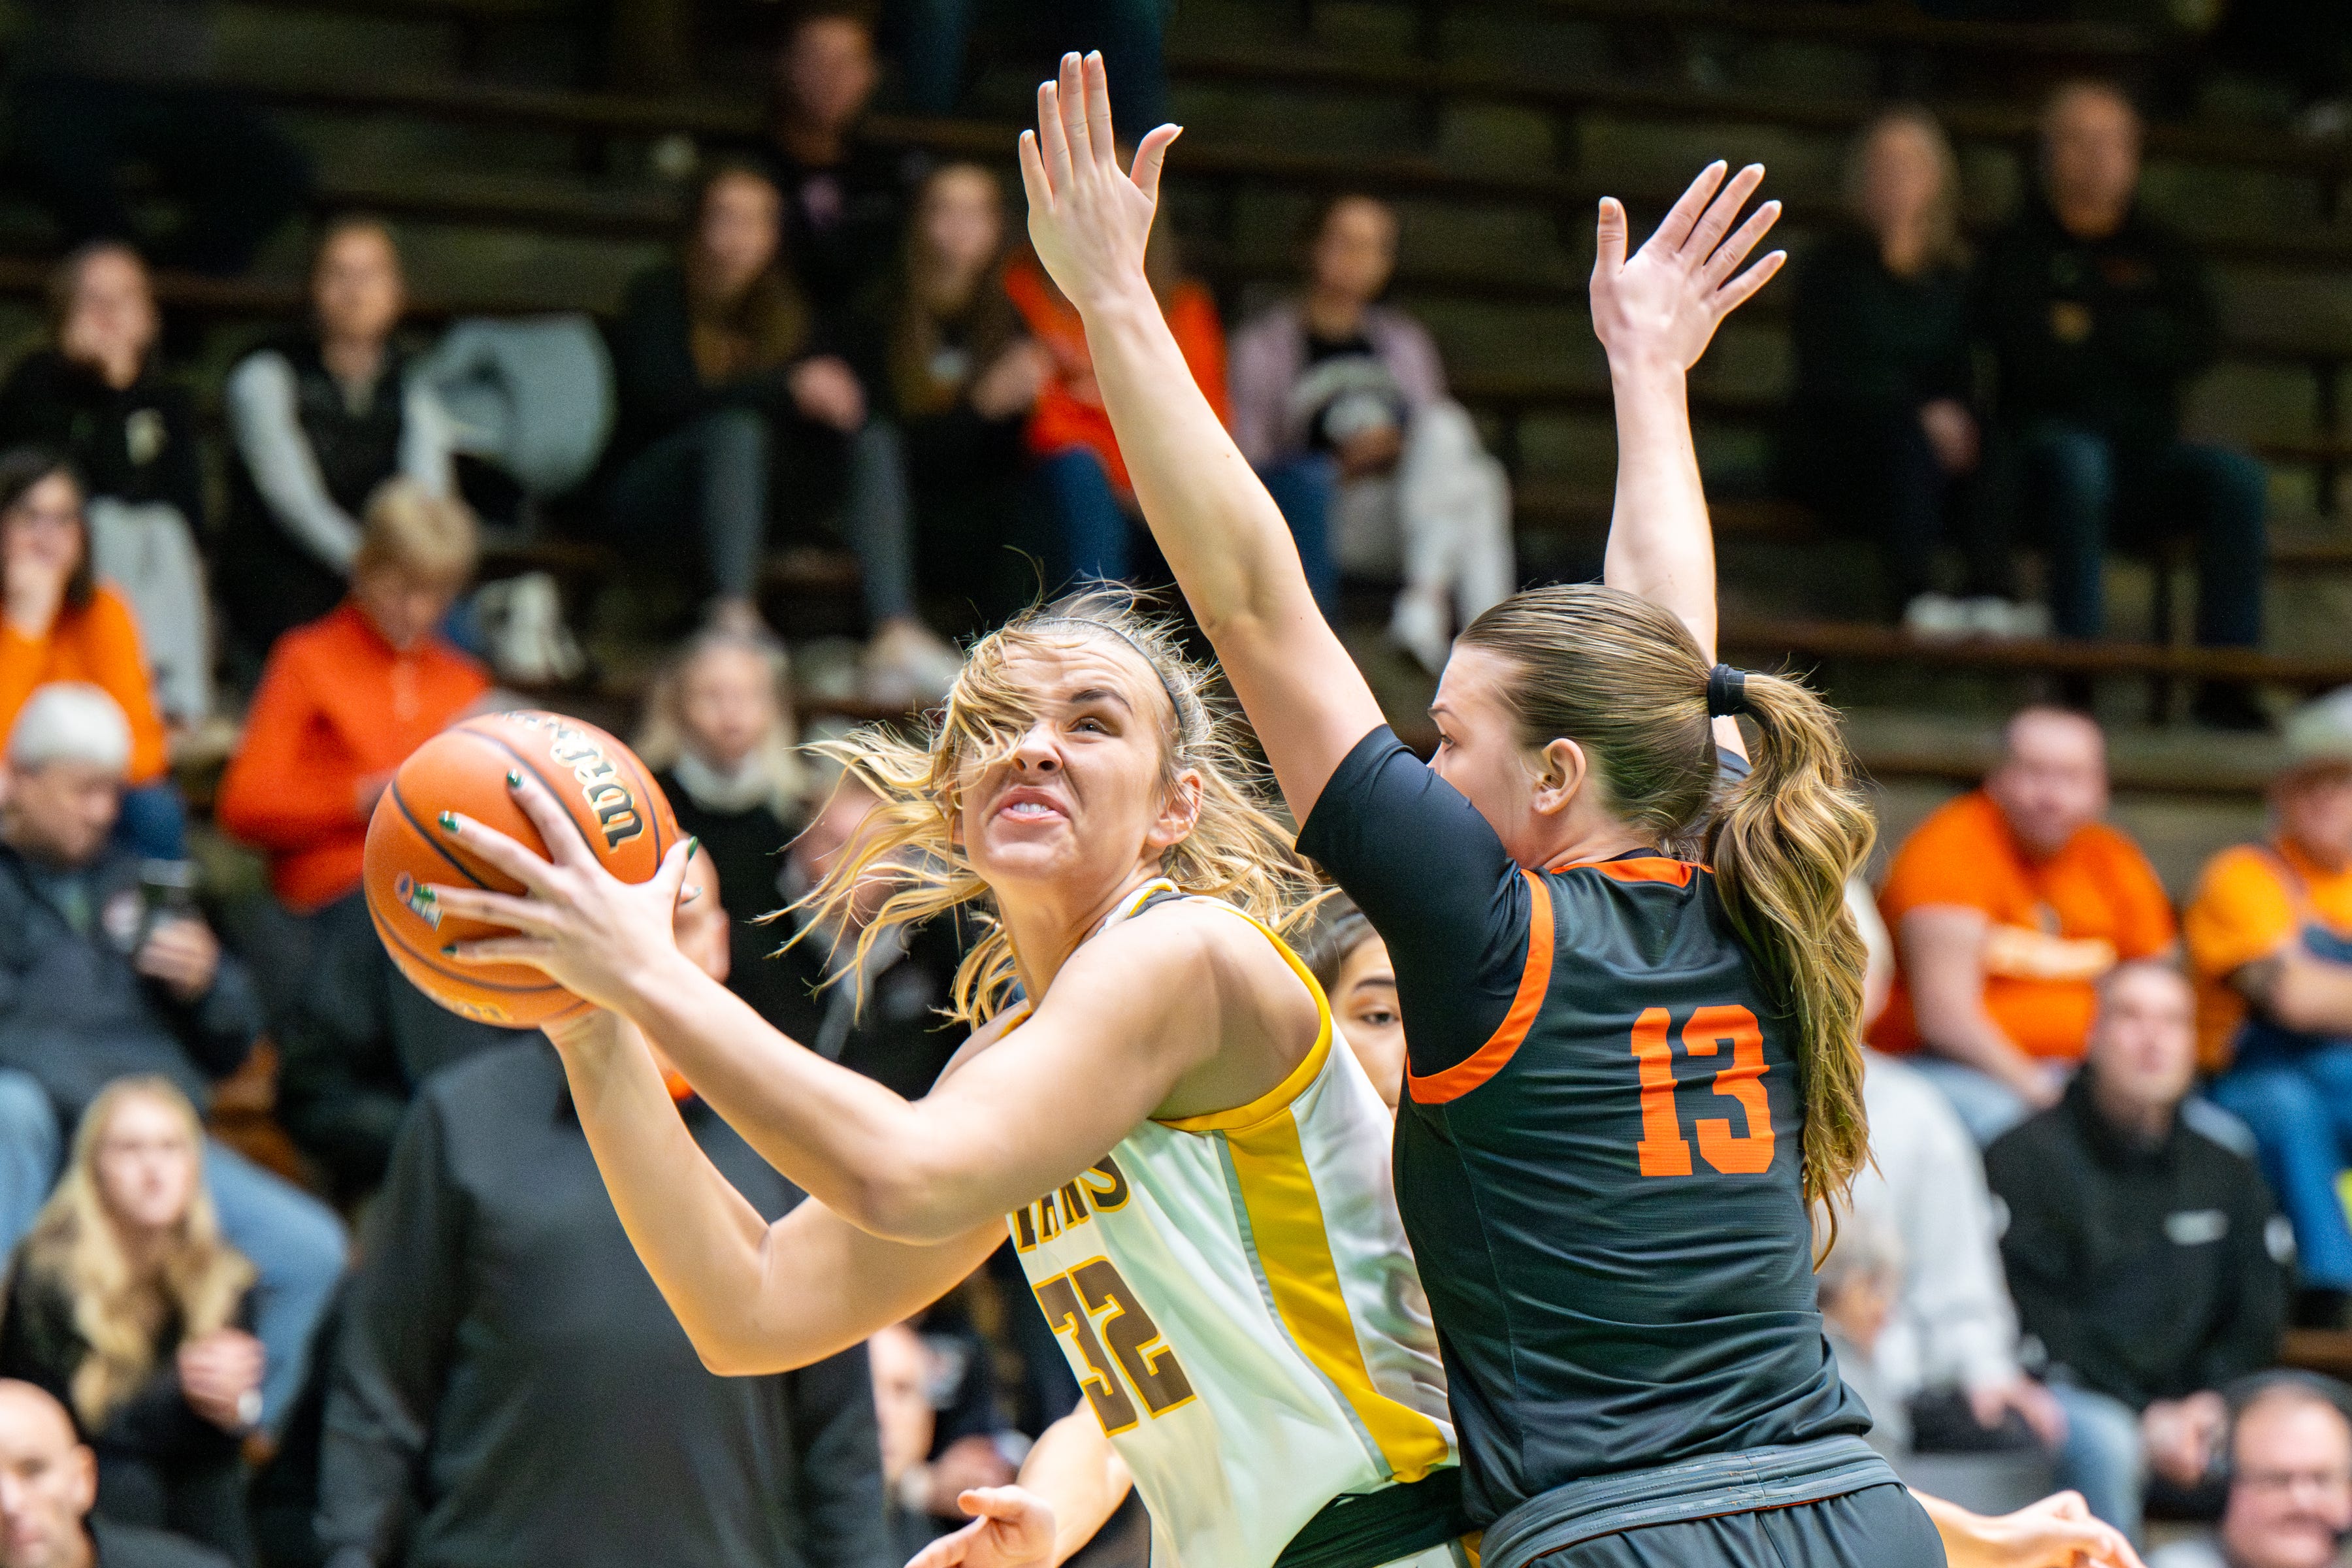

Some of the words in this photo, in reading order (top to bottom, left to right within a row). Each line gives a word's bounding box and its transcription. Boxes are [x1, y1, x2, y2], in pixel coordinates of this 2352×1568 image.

[502, 711, 644, 854] Wil
[1631, 1004, 1775, 1176] 13
[1032, 1255, 1196, 1439] 32
